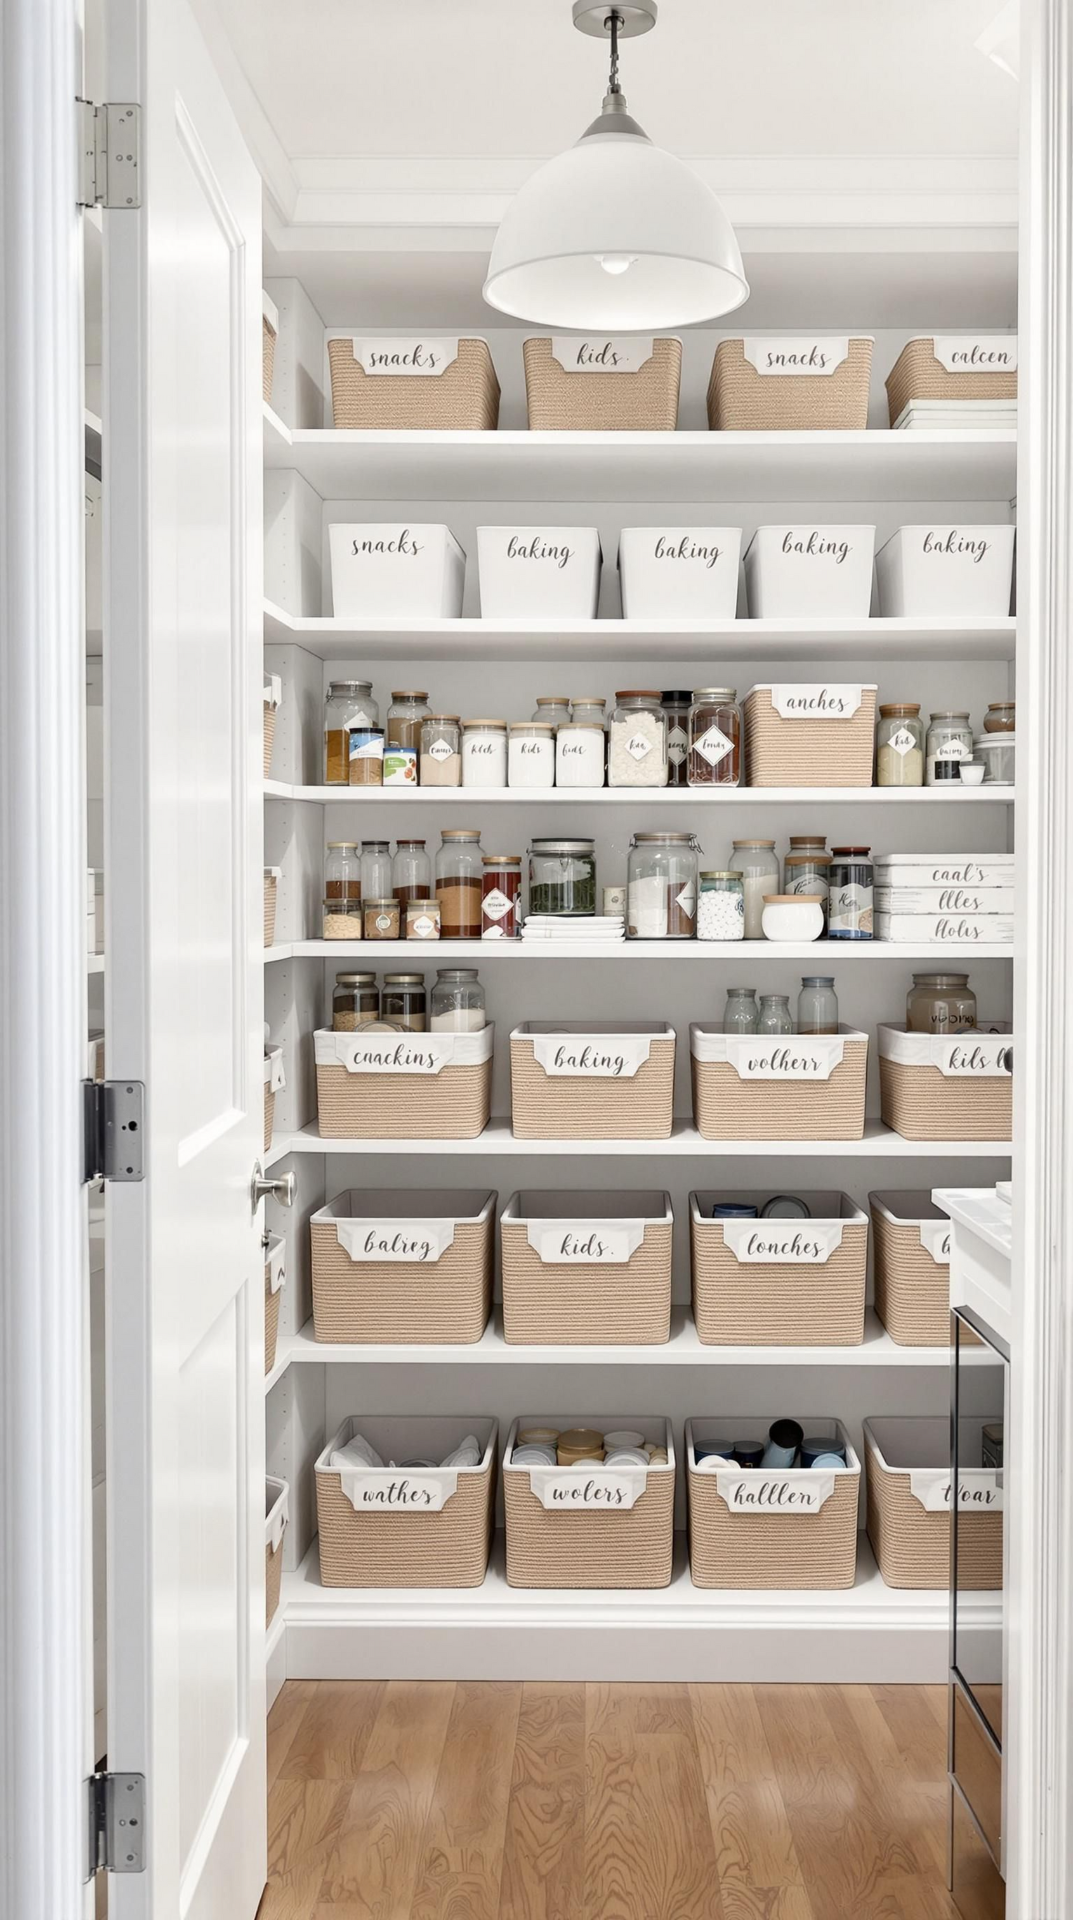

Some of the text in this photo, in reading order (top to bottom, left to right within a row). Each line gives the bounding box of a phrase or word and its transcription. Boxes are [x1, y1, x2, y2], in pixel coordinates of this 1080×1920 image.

[369, 344, 441, 369] snacks
[766, 346, 832, 368] snacks
[351, 529, 425, 556] snacks
[507, 536, 575, 568] baking
[654, 536, 724, 568] baking
[782, 532, 854, 564] baking
[923, 530, 991, 563] baking
[787, 689, 849, 712] anches
[554, 1046, 630, 1075] baking
[748, 1233, 825, 1257] lonches
